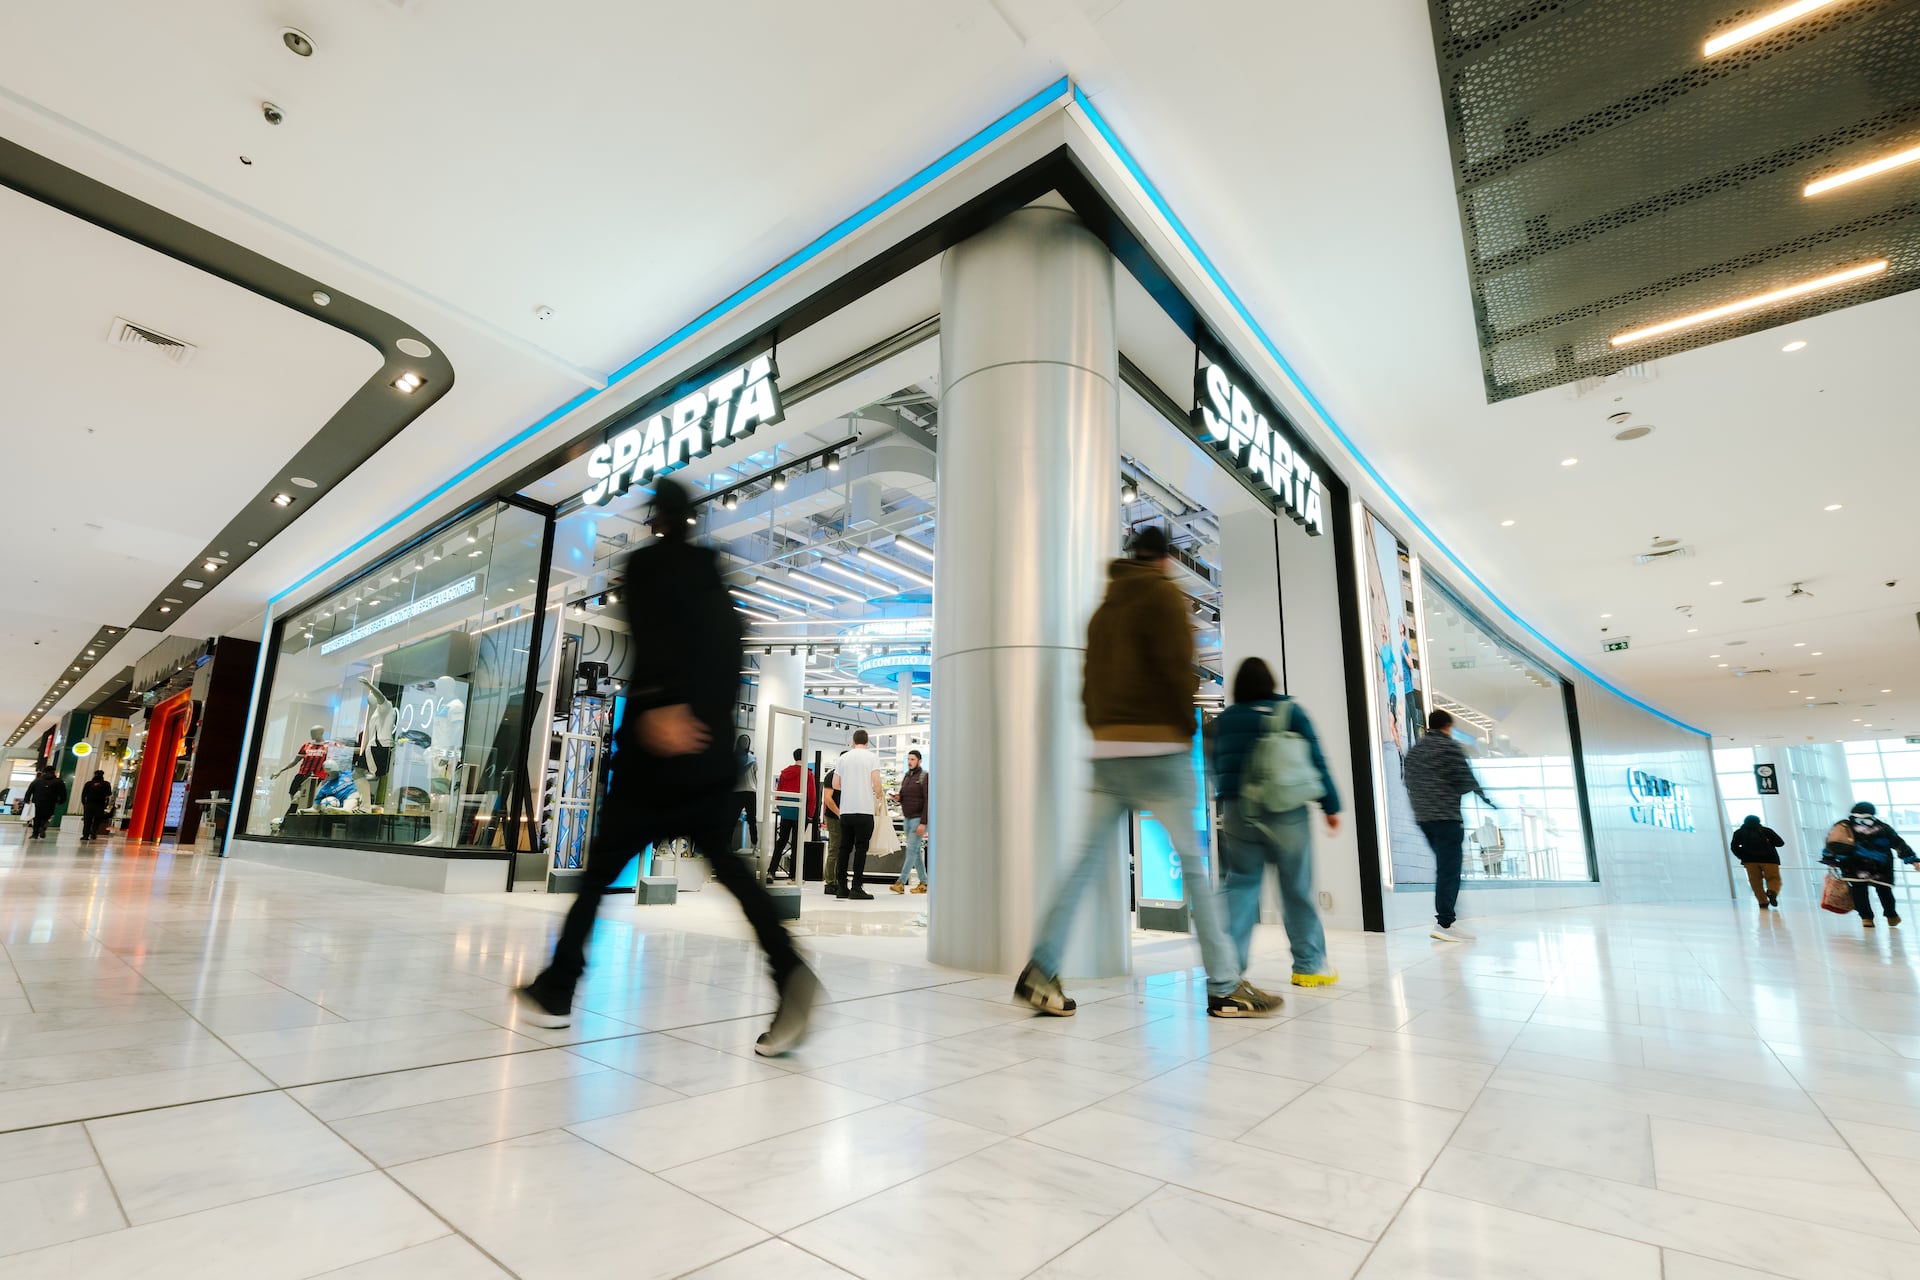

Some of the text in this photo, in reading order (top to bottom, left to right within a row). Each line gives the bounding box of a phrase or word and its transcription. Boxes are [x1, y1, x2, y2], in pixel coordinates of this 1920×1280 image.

[582, 355, 778, 505] SPARTA
[1202, 363, 1324, 536] SPARTA
[872, 655, 918, 668] CONTIGO
